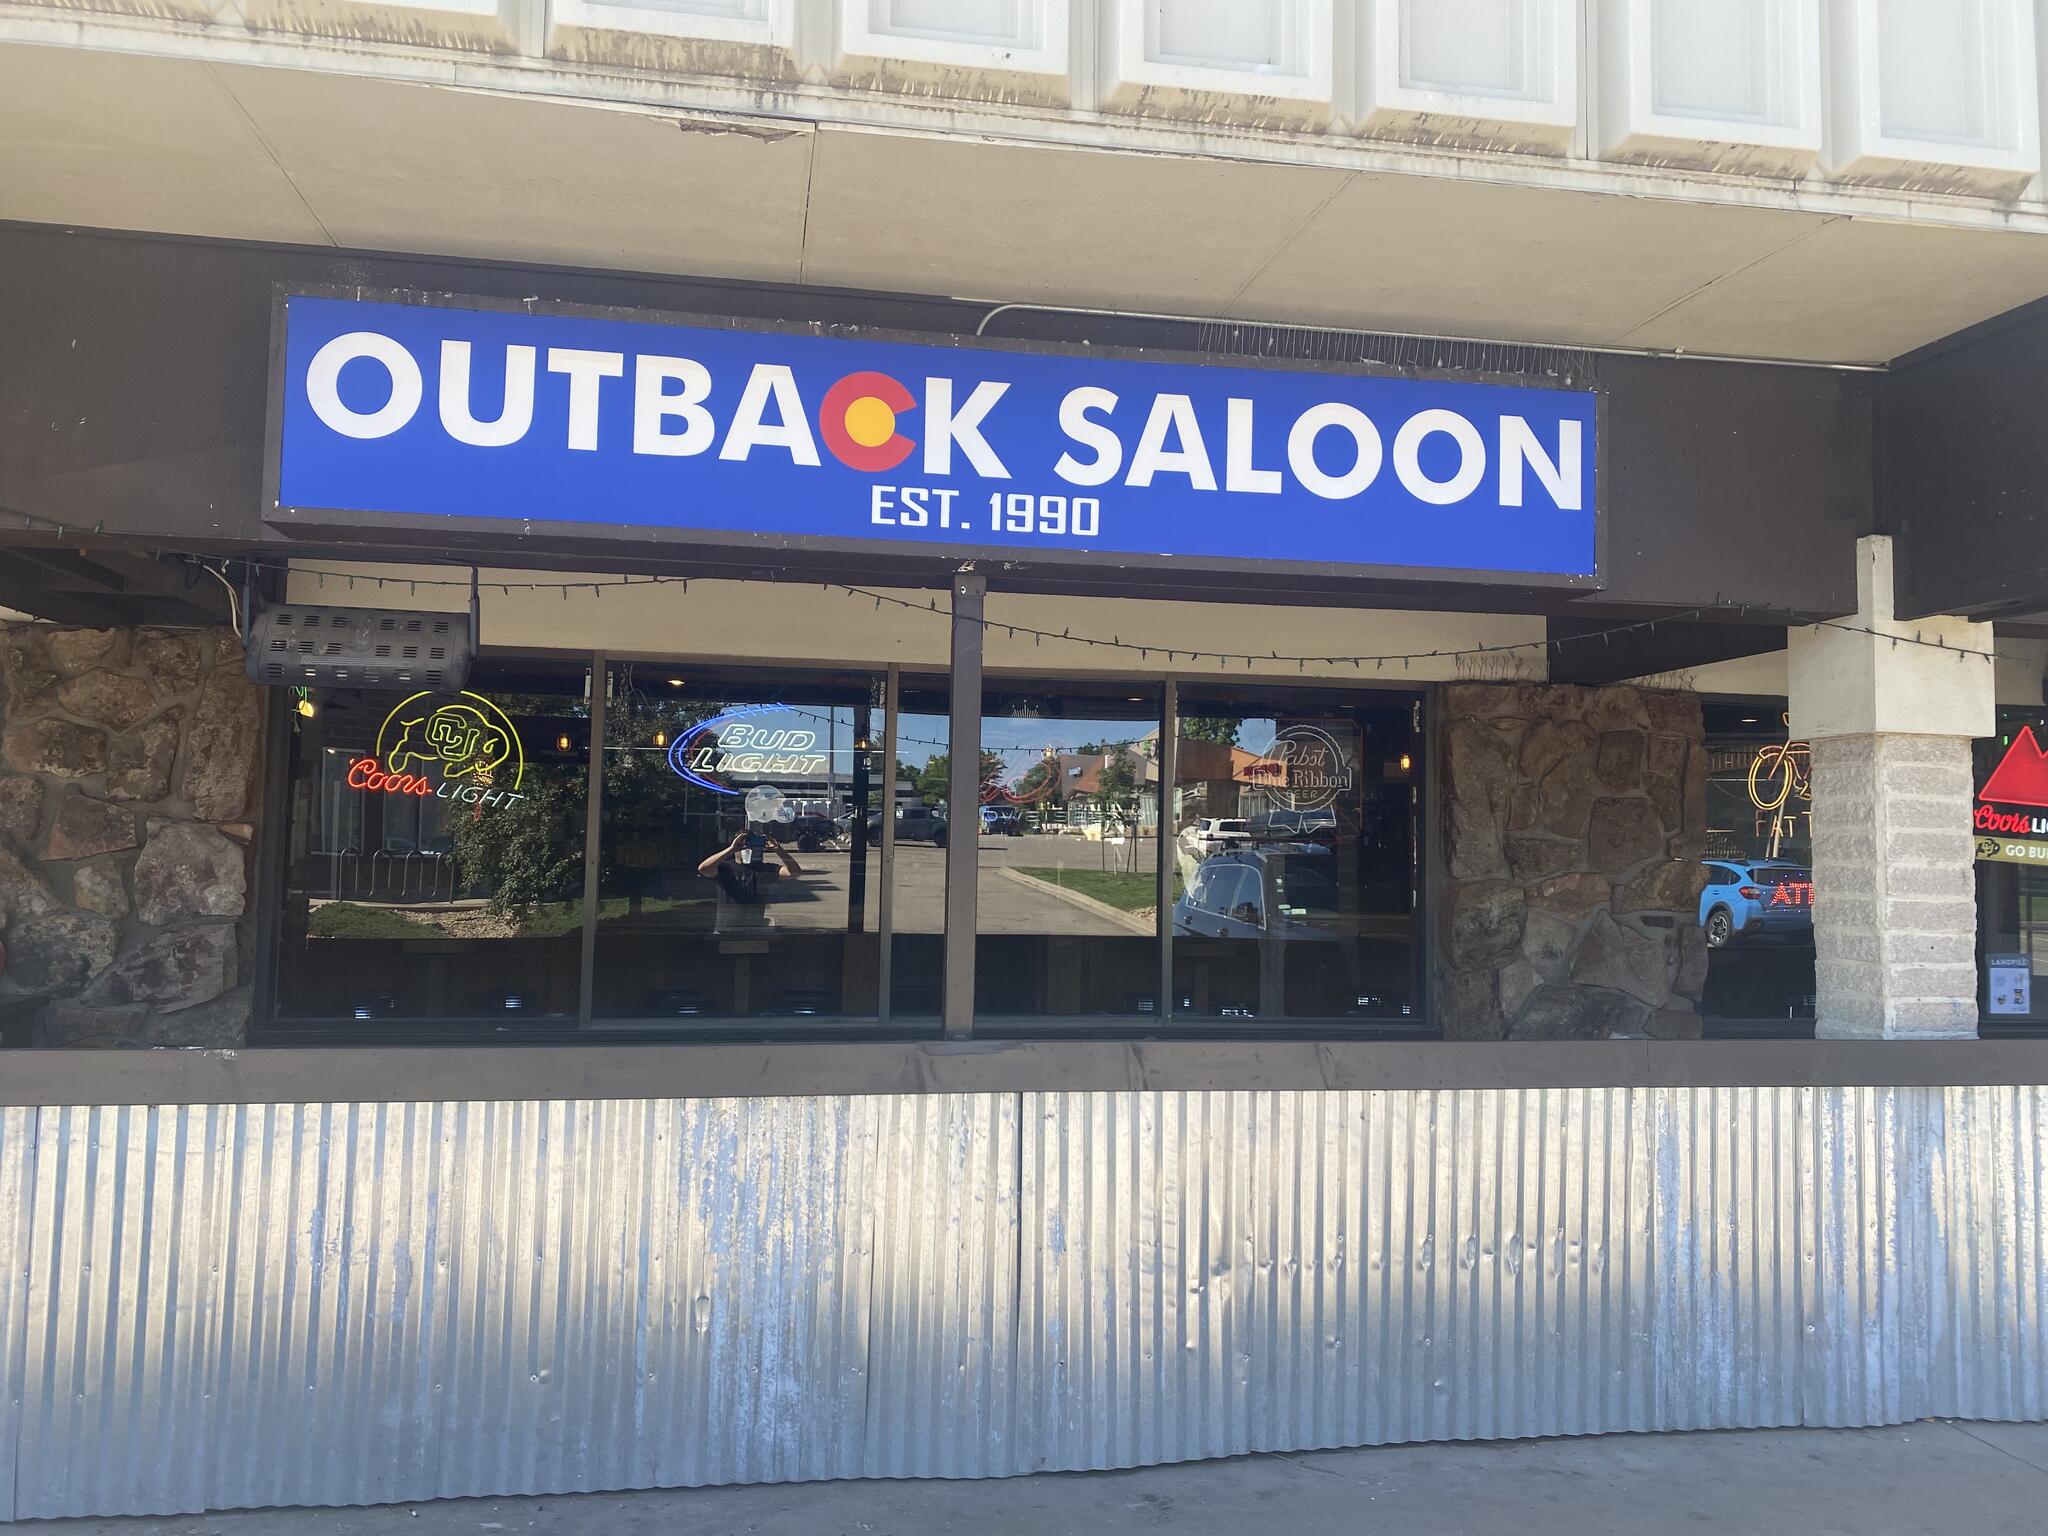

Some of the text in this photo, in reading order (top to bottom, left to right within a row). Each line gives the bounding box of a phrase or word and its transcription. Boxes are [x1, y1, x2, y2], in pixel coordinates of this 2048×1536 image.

[306, 331, 1583, 510] OUTBACK SALOON
[872, 485, 1101, 537] EST. 1990
[717, 724, 815, 751] BUD
[690, 747, 827, 775] LIGHT
[1260, 740, 1329, 767] Pabst
[347, 757, 432, 796] Coors
[436, 783, 524, 810] LIGHT
[1293, 770, 1348, 787] Ribbon
[1755, 809, 1798, 838] FAT
[1975, 804, 2048, 834] Coors LI
[2005, 844, 2026, 857] GO
[2029, 846, 2048, 860] BU
